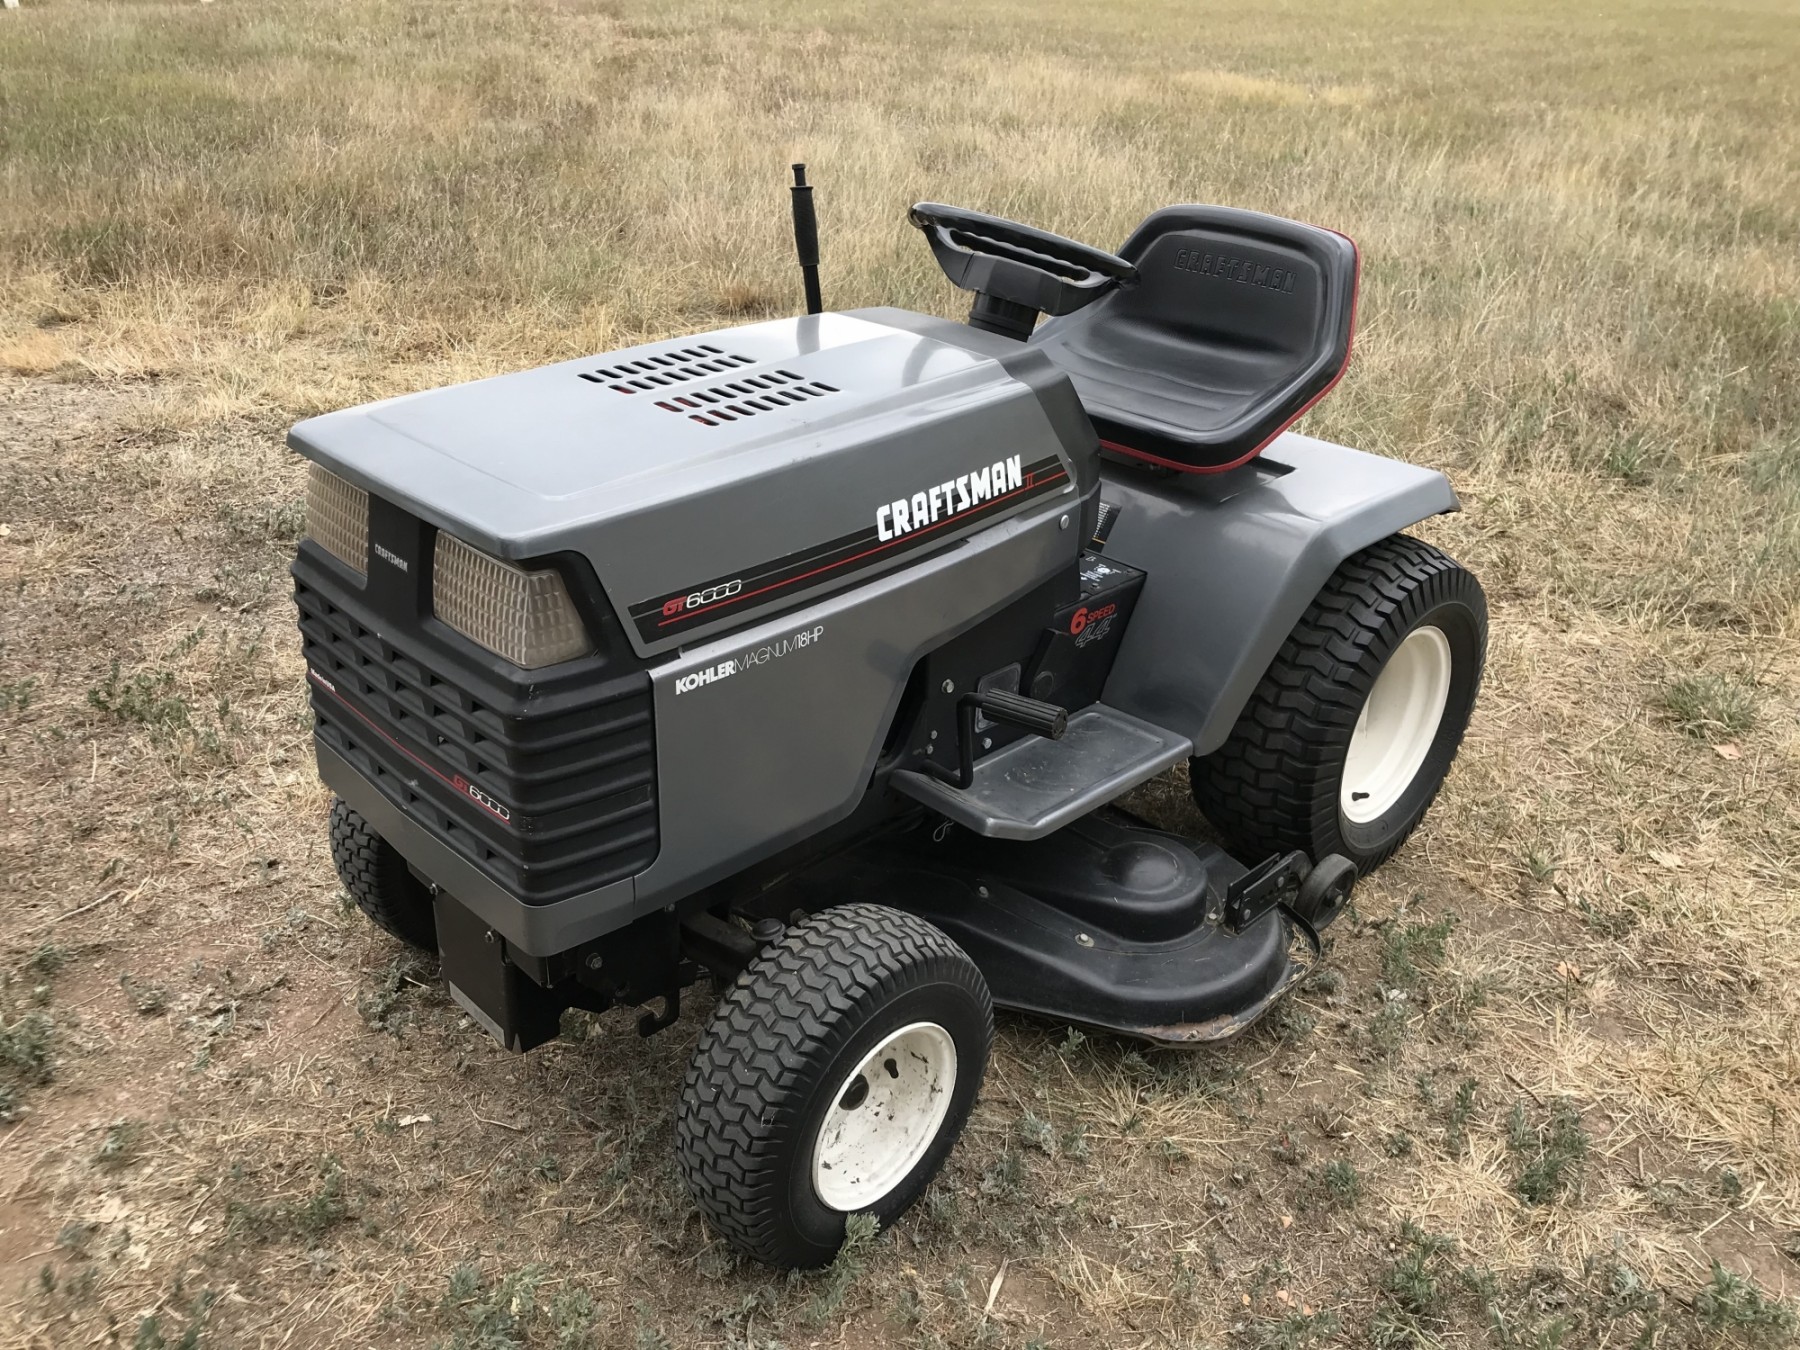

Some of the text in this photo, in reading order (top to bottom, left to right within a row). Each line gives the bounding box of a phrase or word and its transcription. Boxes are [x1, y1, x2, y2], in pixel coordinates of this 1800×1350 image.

[1174, 249, 1297, 294] CRAFTSMAN
[876, 454, 1023, 542] CRAFTSMAN
[1070, 603, 1116, 635] 6 SPEED
